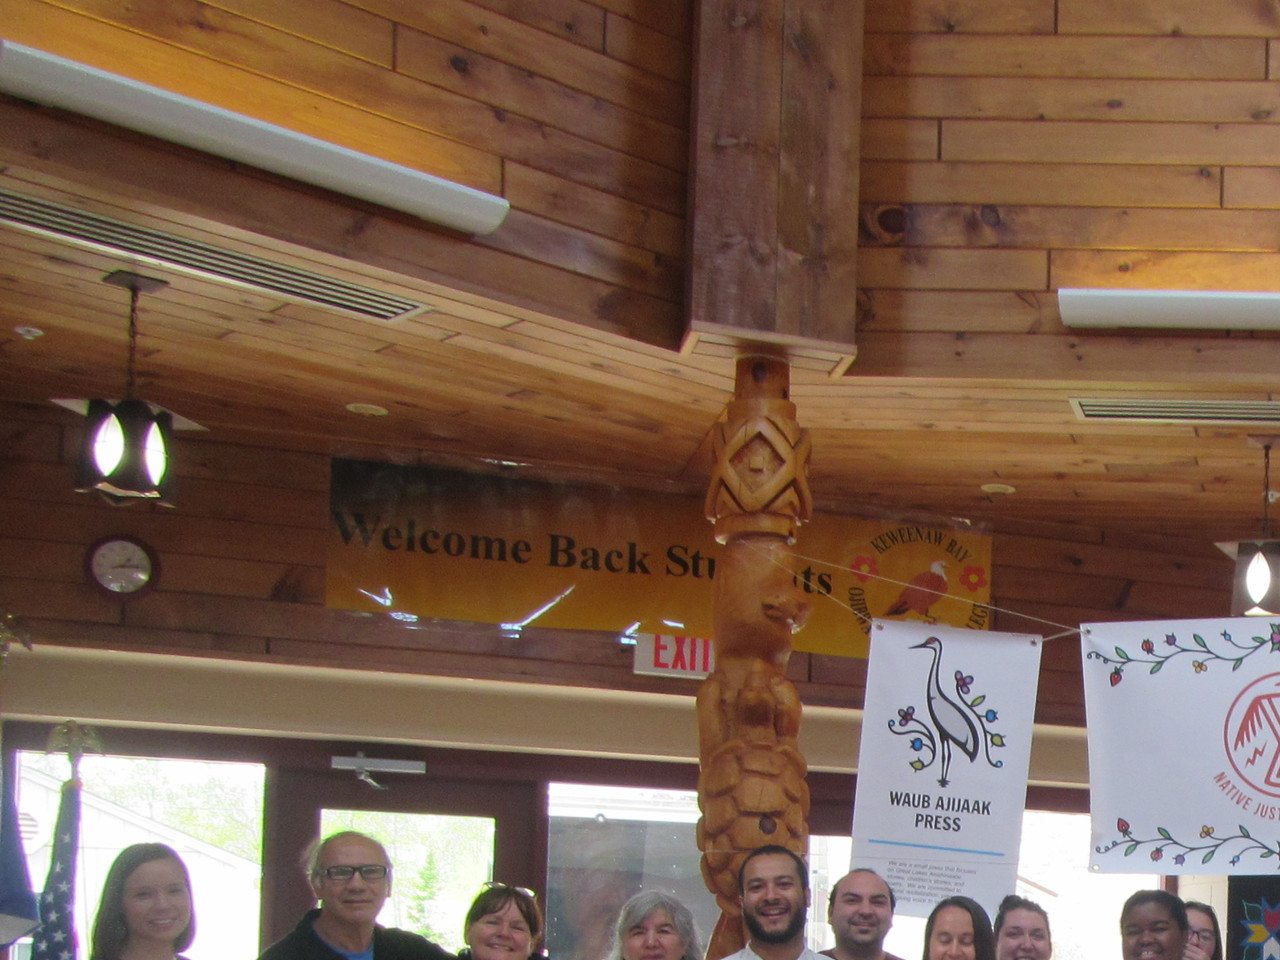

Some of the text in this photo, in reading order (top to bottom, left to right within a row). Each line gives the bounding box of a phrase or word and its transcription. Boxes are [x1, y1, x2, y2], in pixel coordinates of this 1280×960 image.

[330, 508, 532, 564] Welcome
[548, 533, 652, 575] Back
[870, 527, 973, 562] KEWEENAW BAY
[889, 791, 991, 815] WAUB AJIJAAK
[1213, 771, 1253, 811] NATIVE
[915, 814, 961, 832] PRESS
